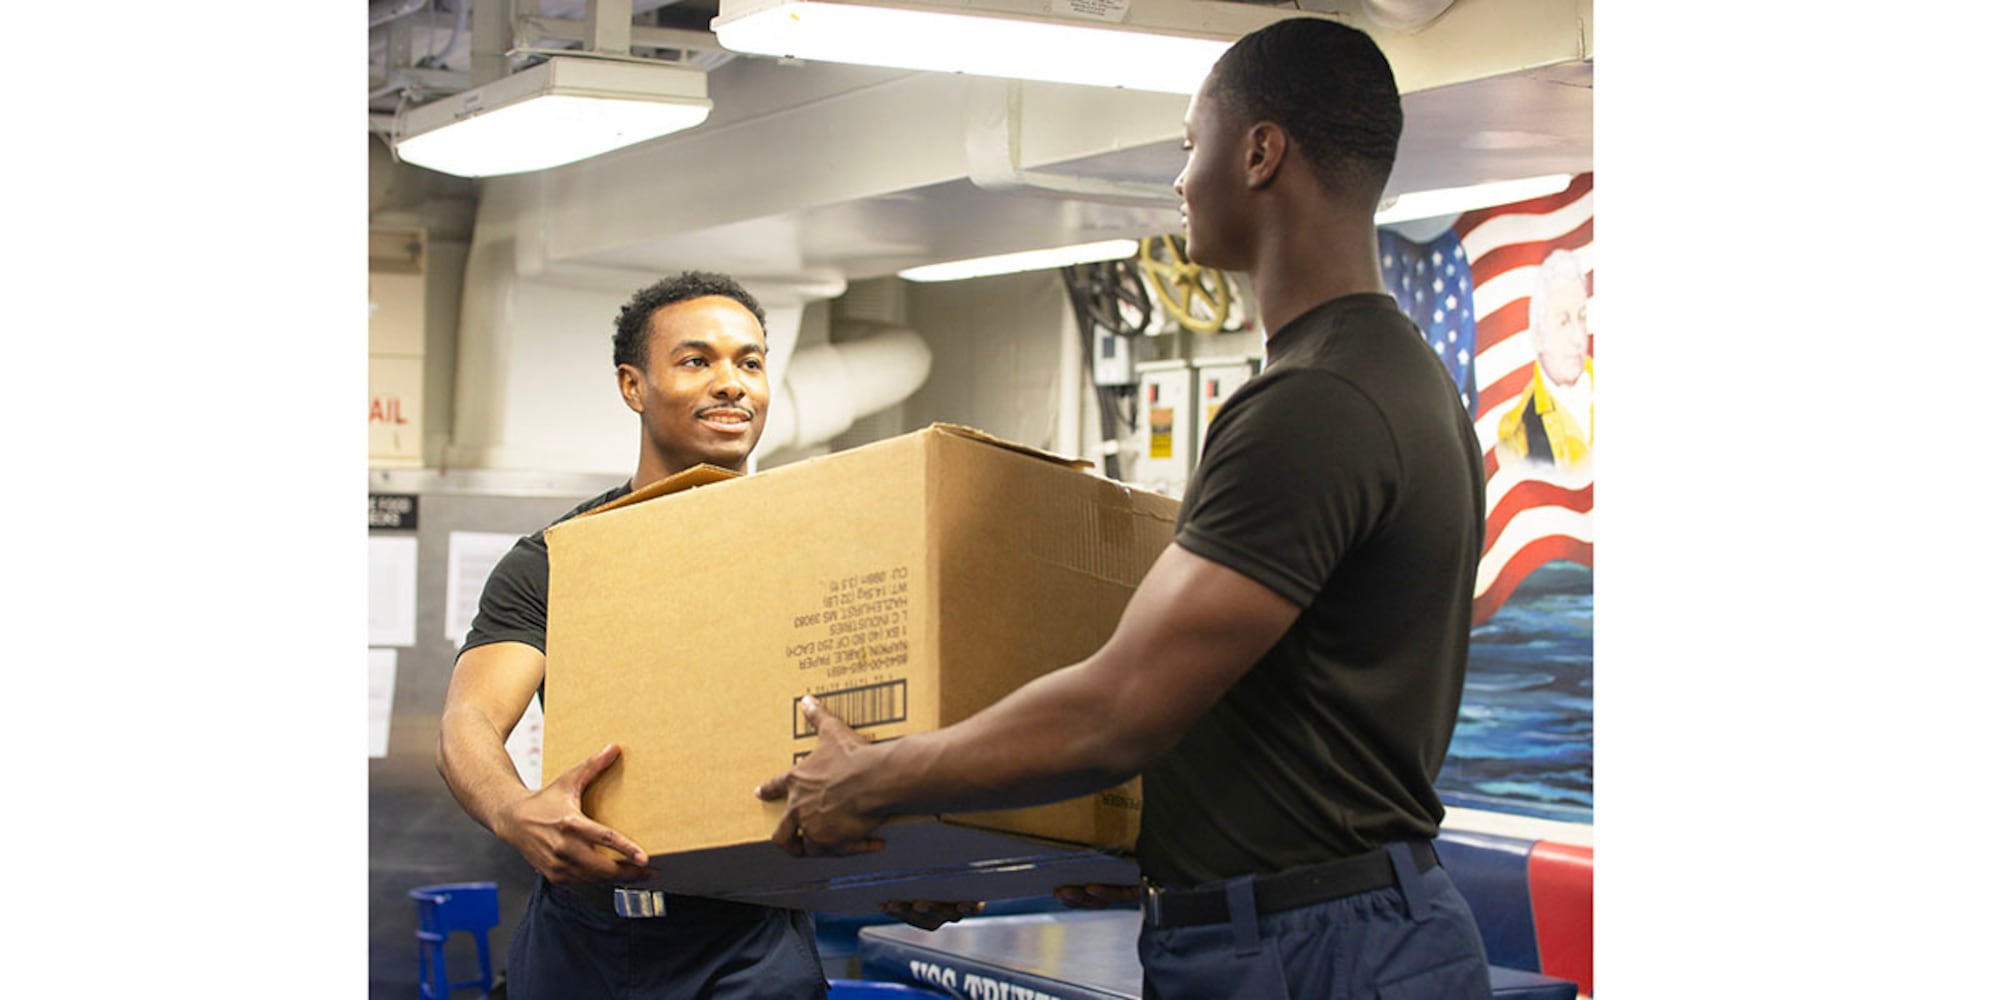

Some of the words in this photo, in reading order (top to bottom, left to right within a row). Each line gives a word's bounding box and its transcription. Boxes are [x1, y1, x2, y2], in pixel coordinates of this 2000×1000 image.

[369, 398, 408, 423] AIL
[823, 610, 838, 624] MS
[892, 611, 900, 625] C
[829, 614, 889, 636] INDUSTRIES
[887, 627, 900, 639] BX
[817, 639, 834, 652] 250
[837, 635, 850, 649] OF
[786, 642, 815, 658] EACH)
[799, 653, 831, 670] PAPER
